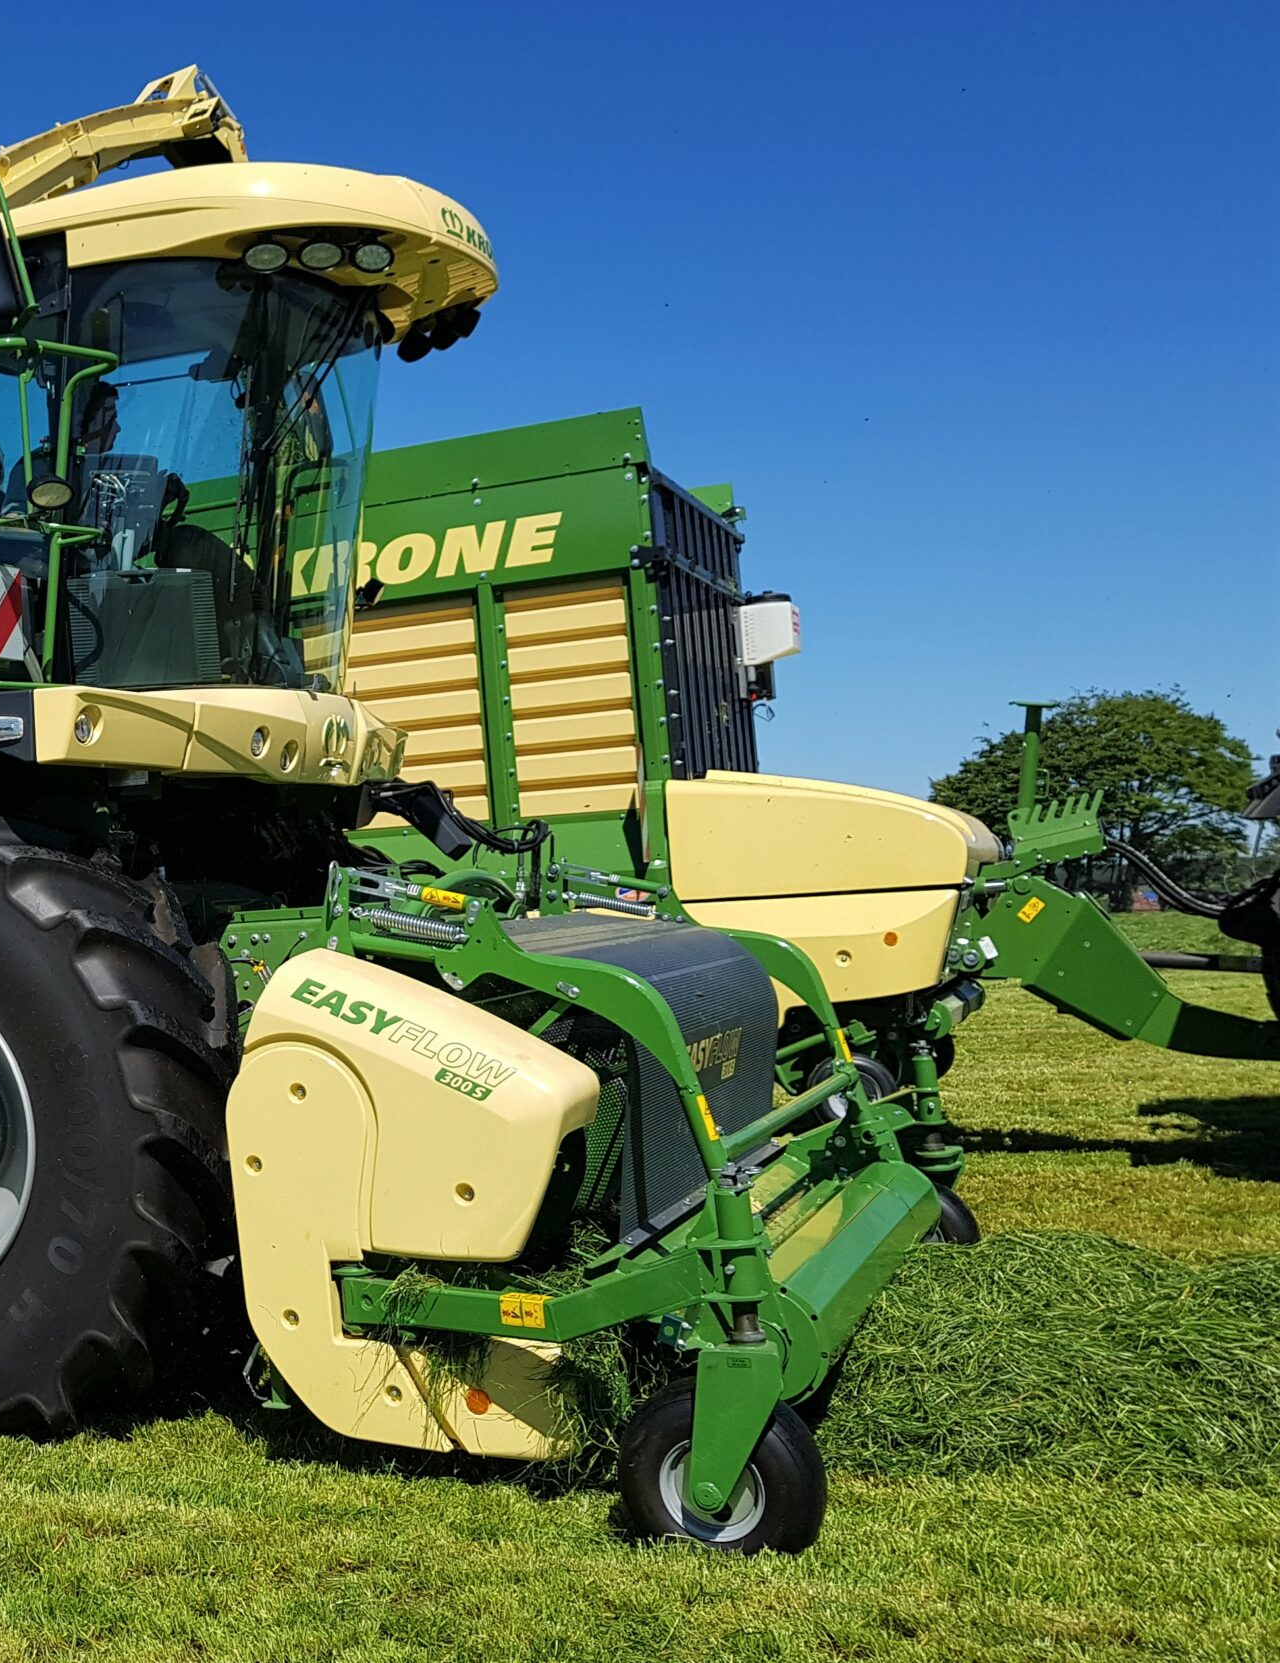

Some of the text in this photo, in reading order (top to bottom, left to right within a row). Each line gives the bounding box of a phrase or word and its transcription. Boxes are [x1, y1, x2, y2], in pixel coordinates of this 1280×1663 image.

[466, 223, 496, 264] KRO
[290, 978, 519, 1087] EASYFLOW
[438, 1071, 487, 1099] 300 S
